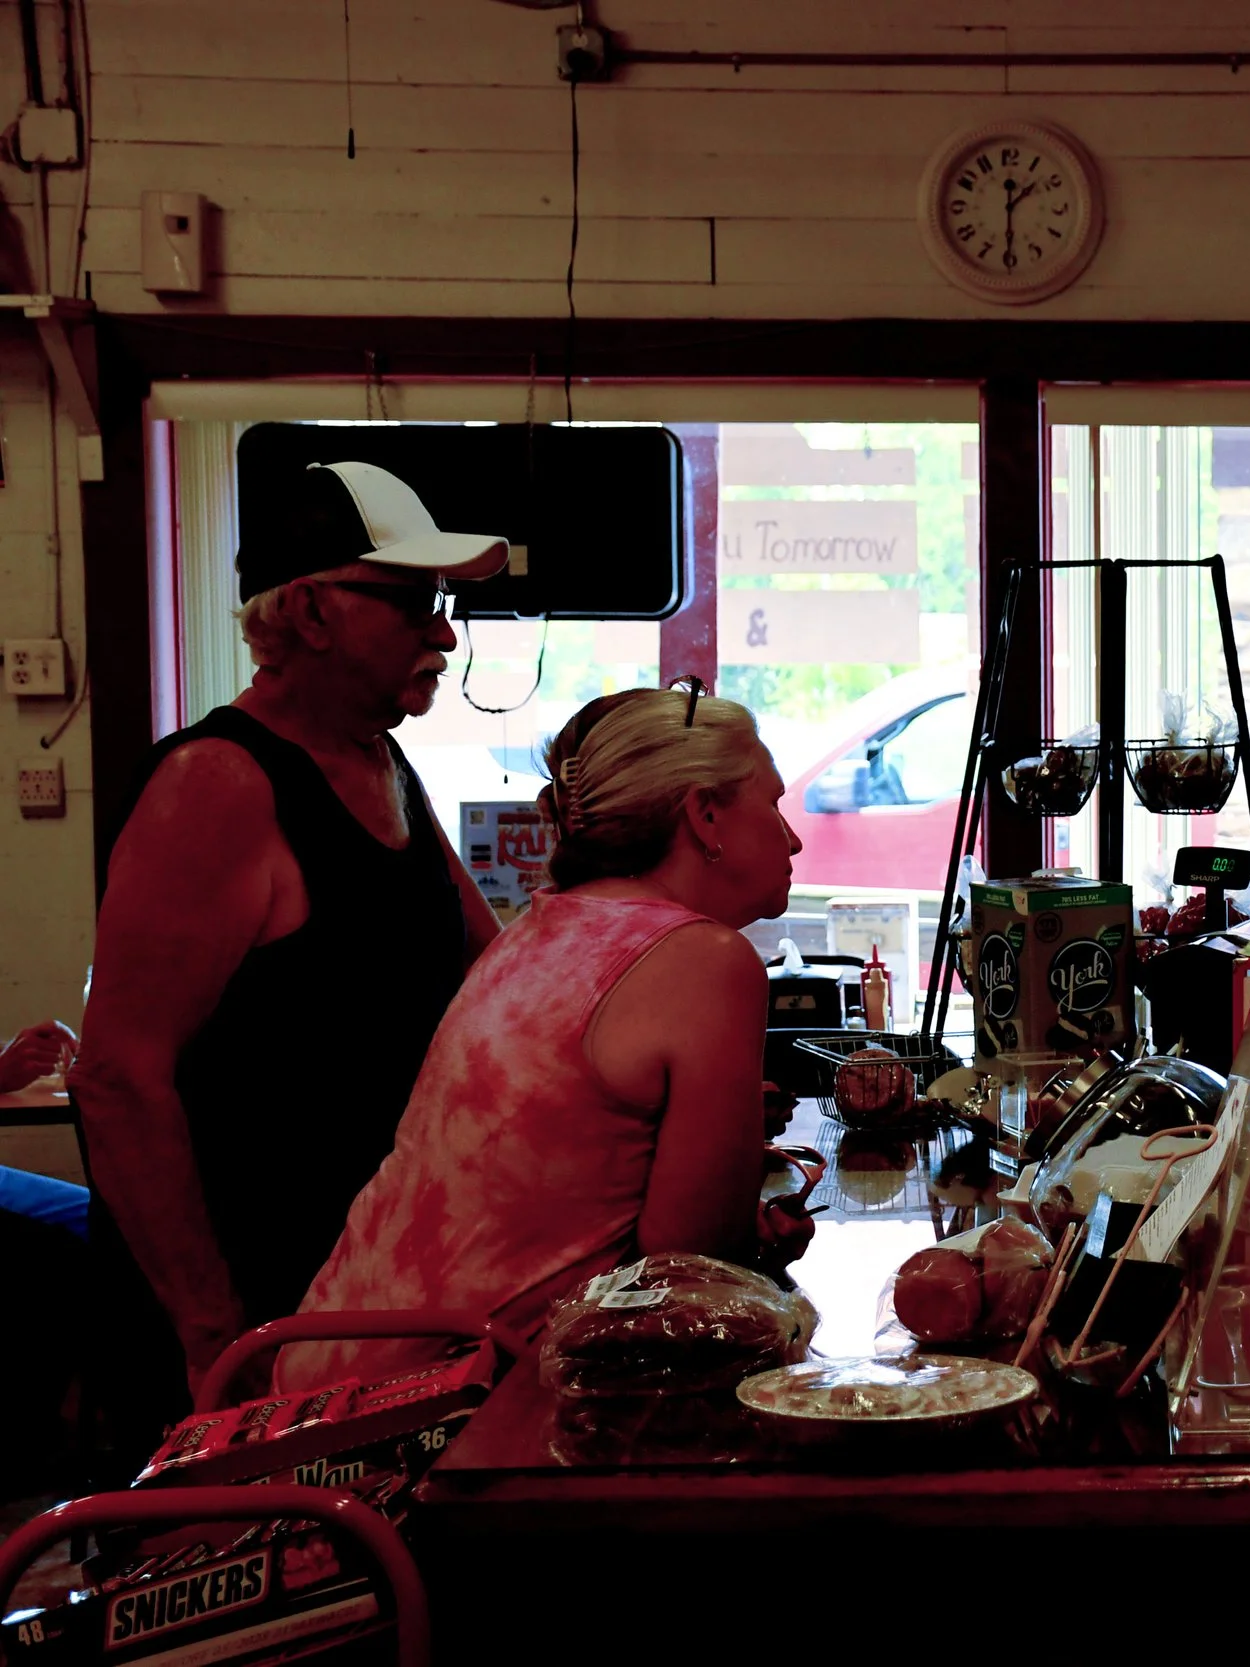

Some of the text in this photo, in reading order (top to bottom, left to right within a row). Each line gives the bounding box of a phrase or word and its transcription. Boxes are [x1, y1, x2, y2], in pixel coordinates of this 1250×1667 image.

[1002, 149, 1020, 167] 12
[755, 520, 898, 563] Tomorrow
[746, 608, 768, 647] &
[1189, 873, 1221, 883] SHARP
[1073, 894, 1088, 903] LESS
[1089, 893, 1101, 901] FAT
[979, 949, 1016, 1017] York
[1050, 950, 1109, 1016] York
[417, 1426, 446, 1451] 36
[113, 1556, 264, 1641] SNICKERS
[18, 1620, 45, 1647] 48
